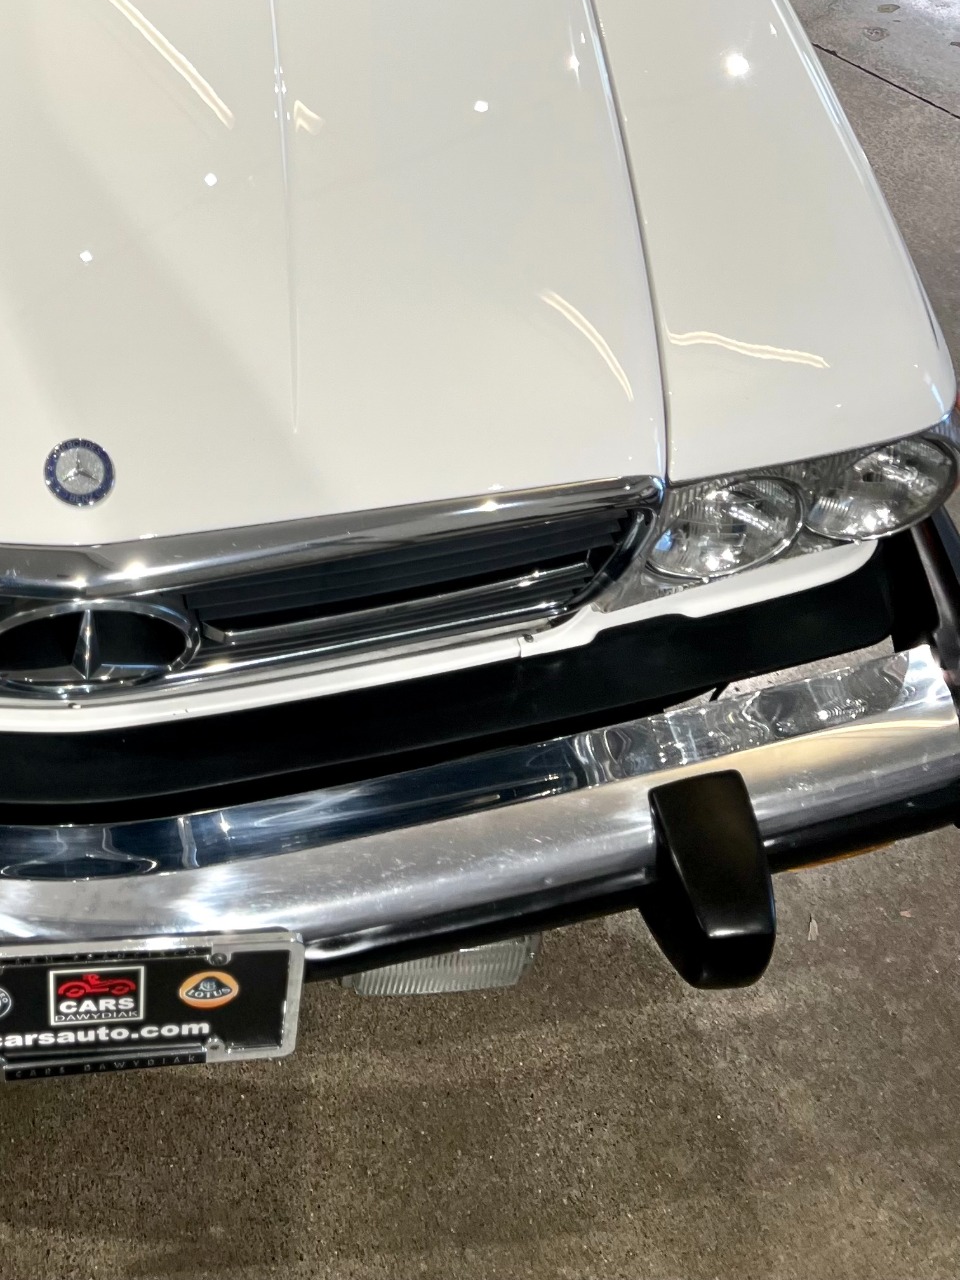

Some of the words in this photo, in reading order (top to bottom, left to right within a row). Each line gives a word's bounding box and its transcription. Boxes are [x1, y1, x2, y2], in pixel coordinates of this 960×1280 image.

[187, 987, 231, 999] LOTUS
[59, 998, 135, 1013] CARS
[55, 1011, 138, 1022] DAWYDIAK
[83, 1055, 196, 1071] DAWYDIAK
